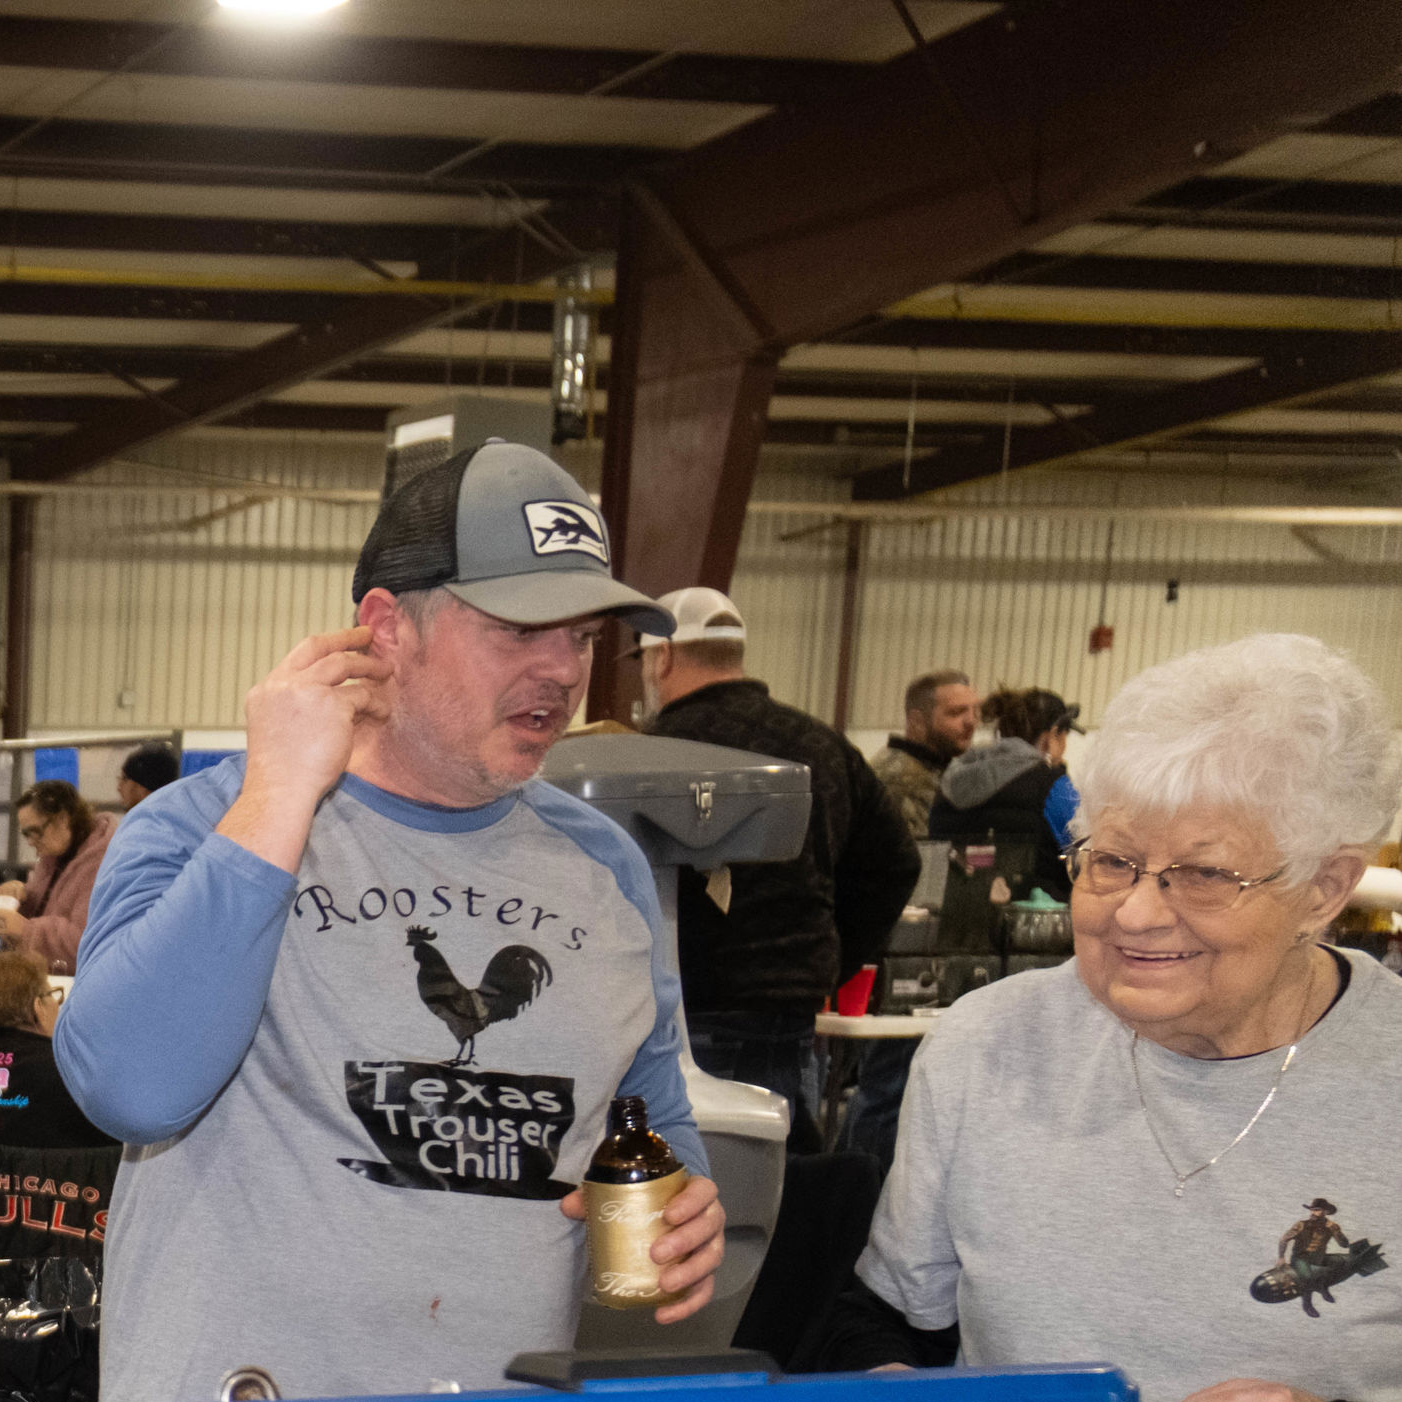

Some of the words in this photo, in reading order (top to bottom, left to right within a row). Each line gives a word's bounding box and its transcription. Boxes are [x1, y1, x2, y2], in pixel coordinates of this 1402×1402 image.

[293, 884, 588, 951] Roosters
[357, 1064, 563, 1114] Texas
[373, 1103, 558, 1150] Trouser
[418, 1140, 520, 1181] Chili
